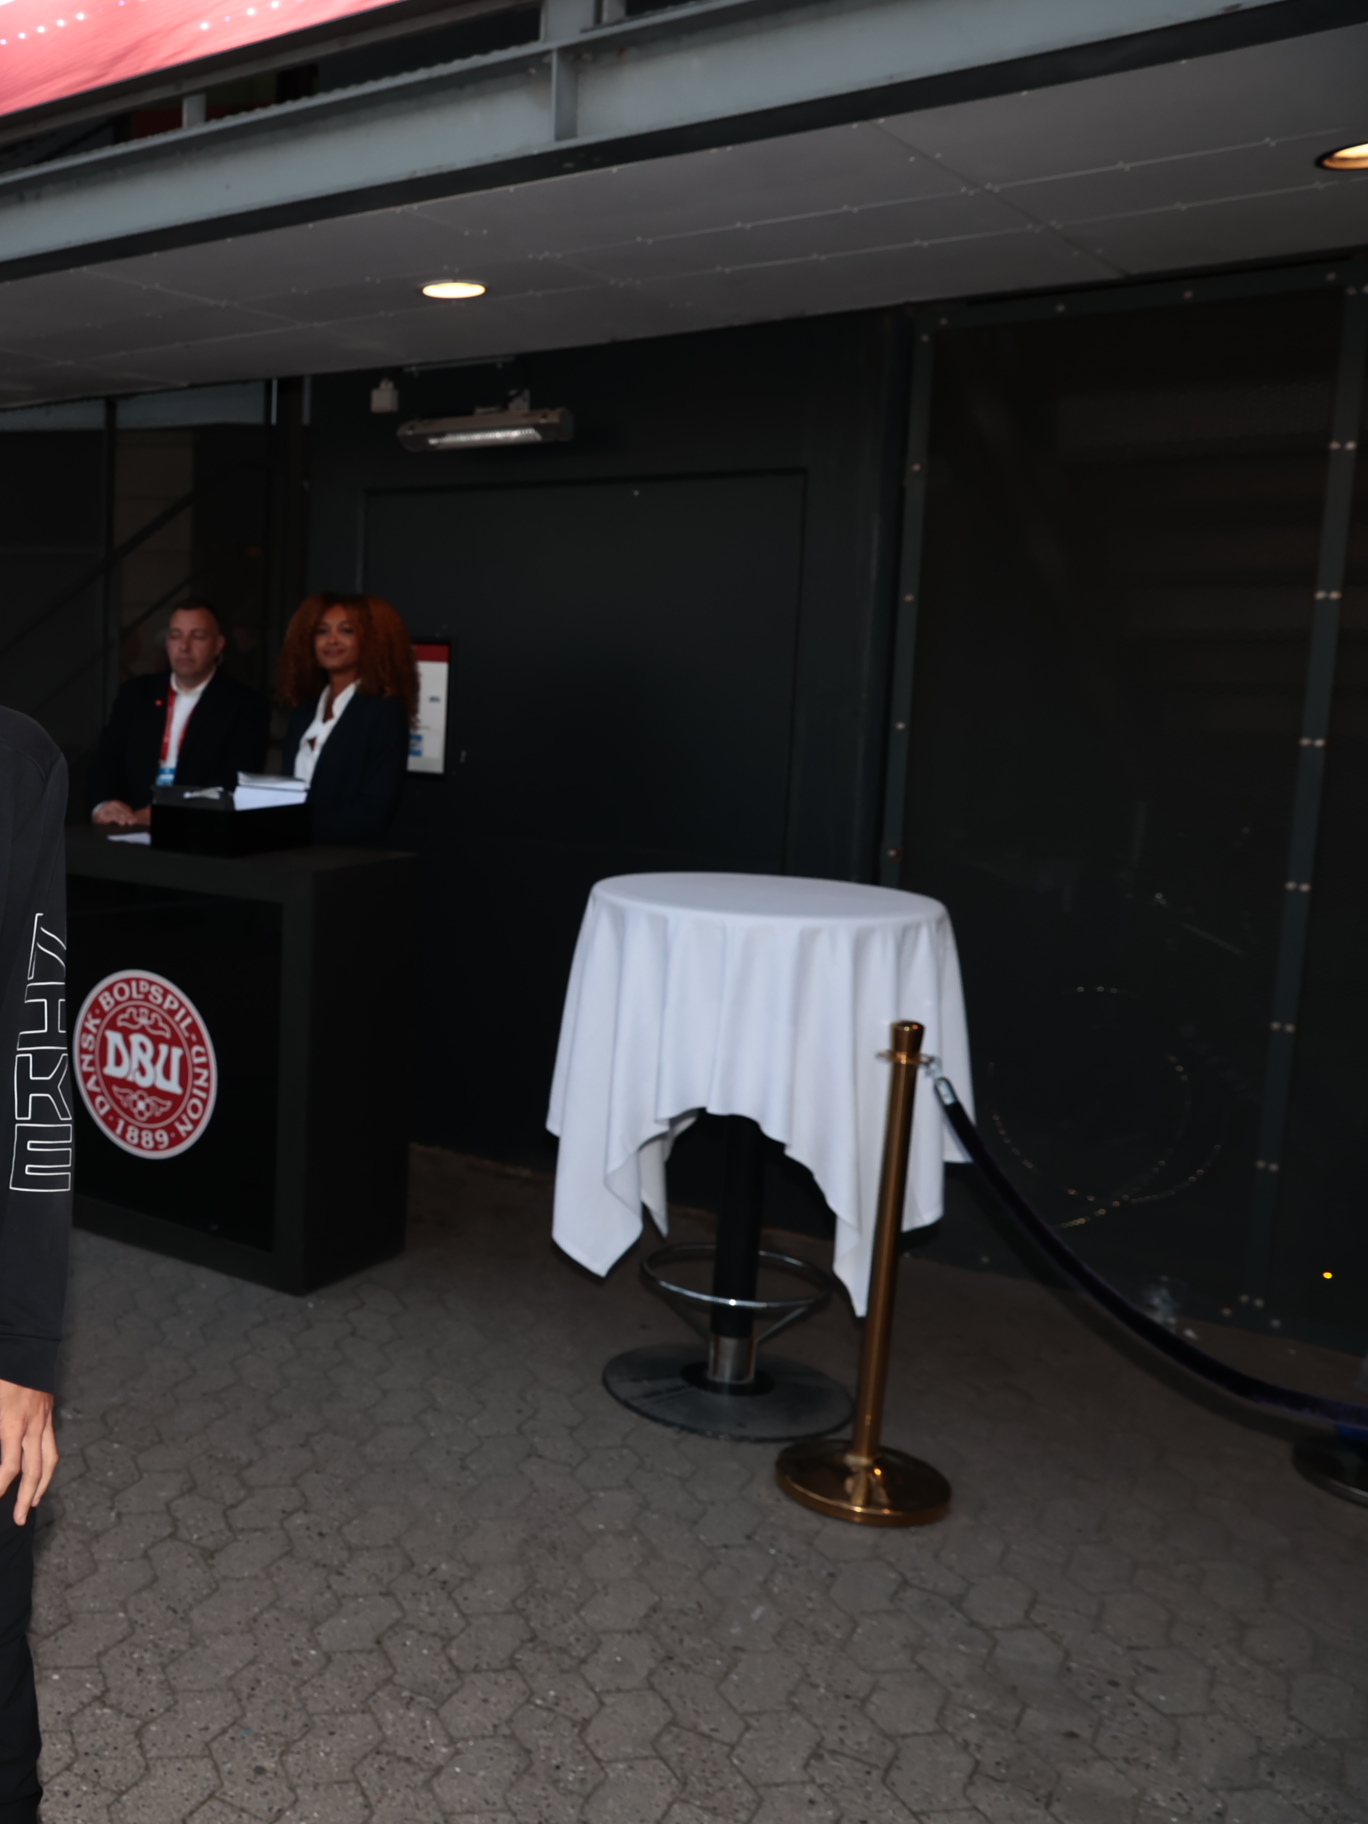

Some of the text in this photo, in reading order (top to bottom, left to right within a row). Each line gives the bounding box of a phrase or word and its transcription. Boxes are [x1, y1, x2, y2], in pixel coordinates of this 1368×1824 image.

[81, 1012, 111, 1117] DANSK
[102, 1029, 184, 1096] DBU
[115, 1116, 169, 1150] 1889
